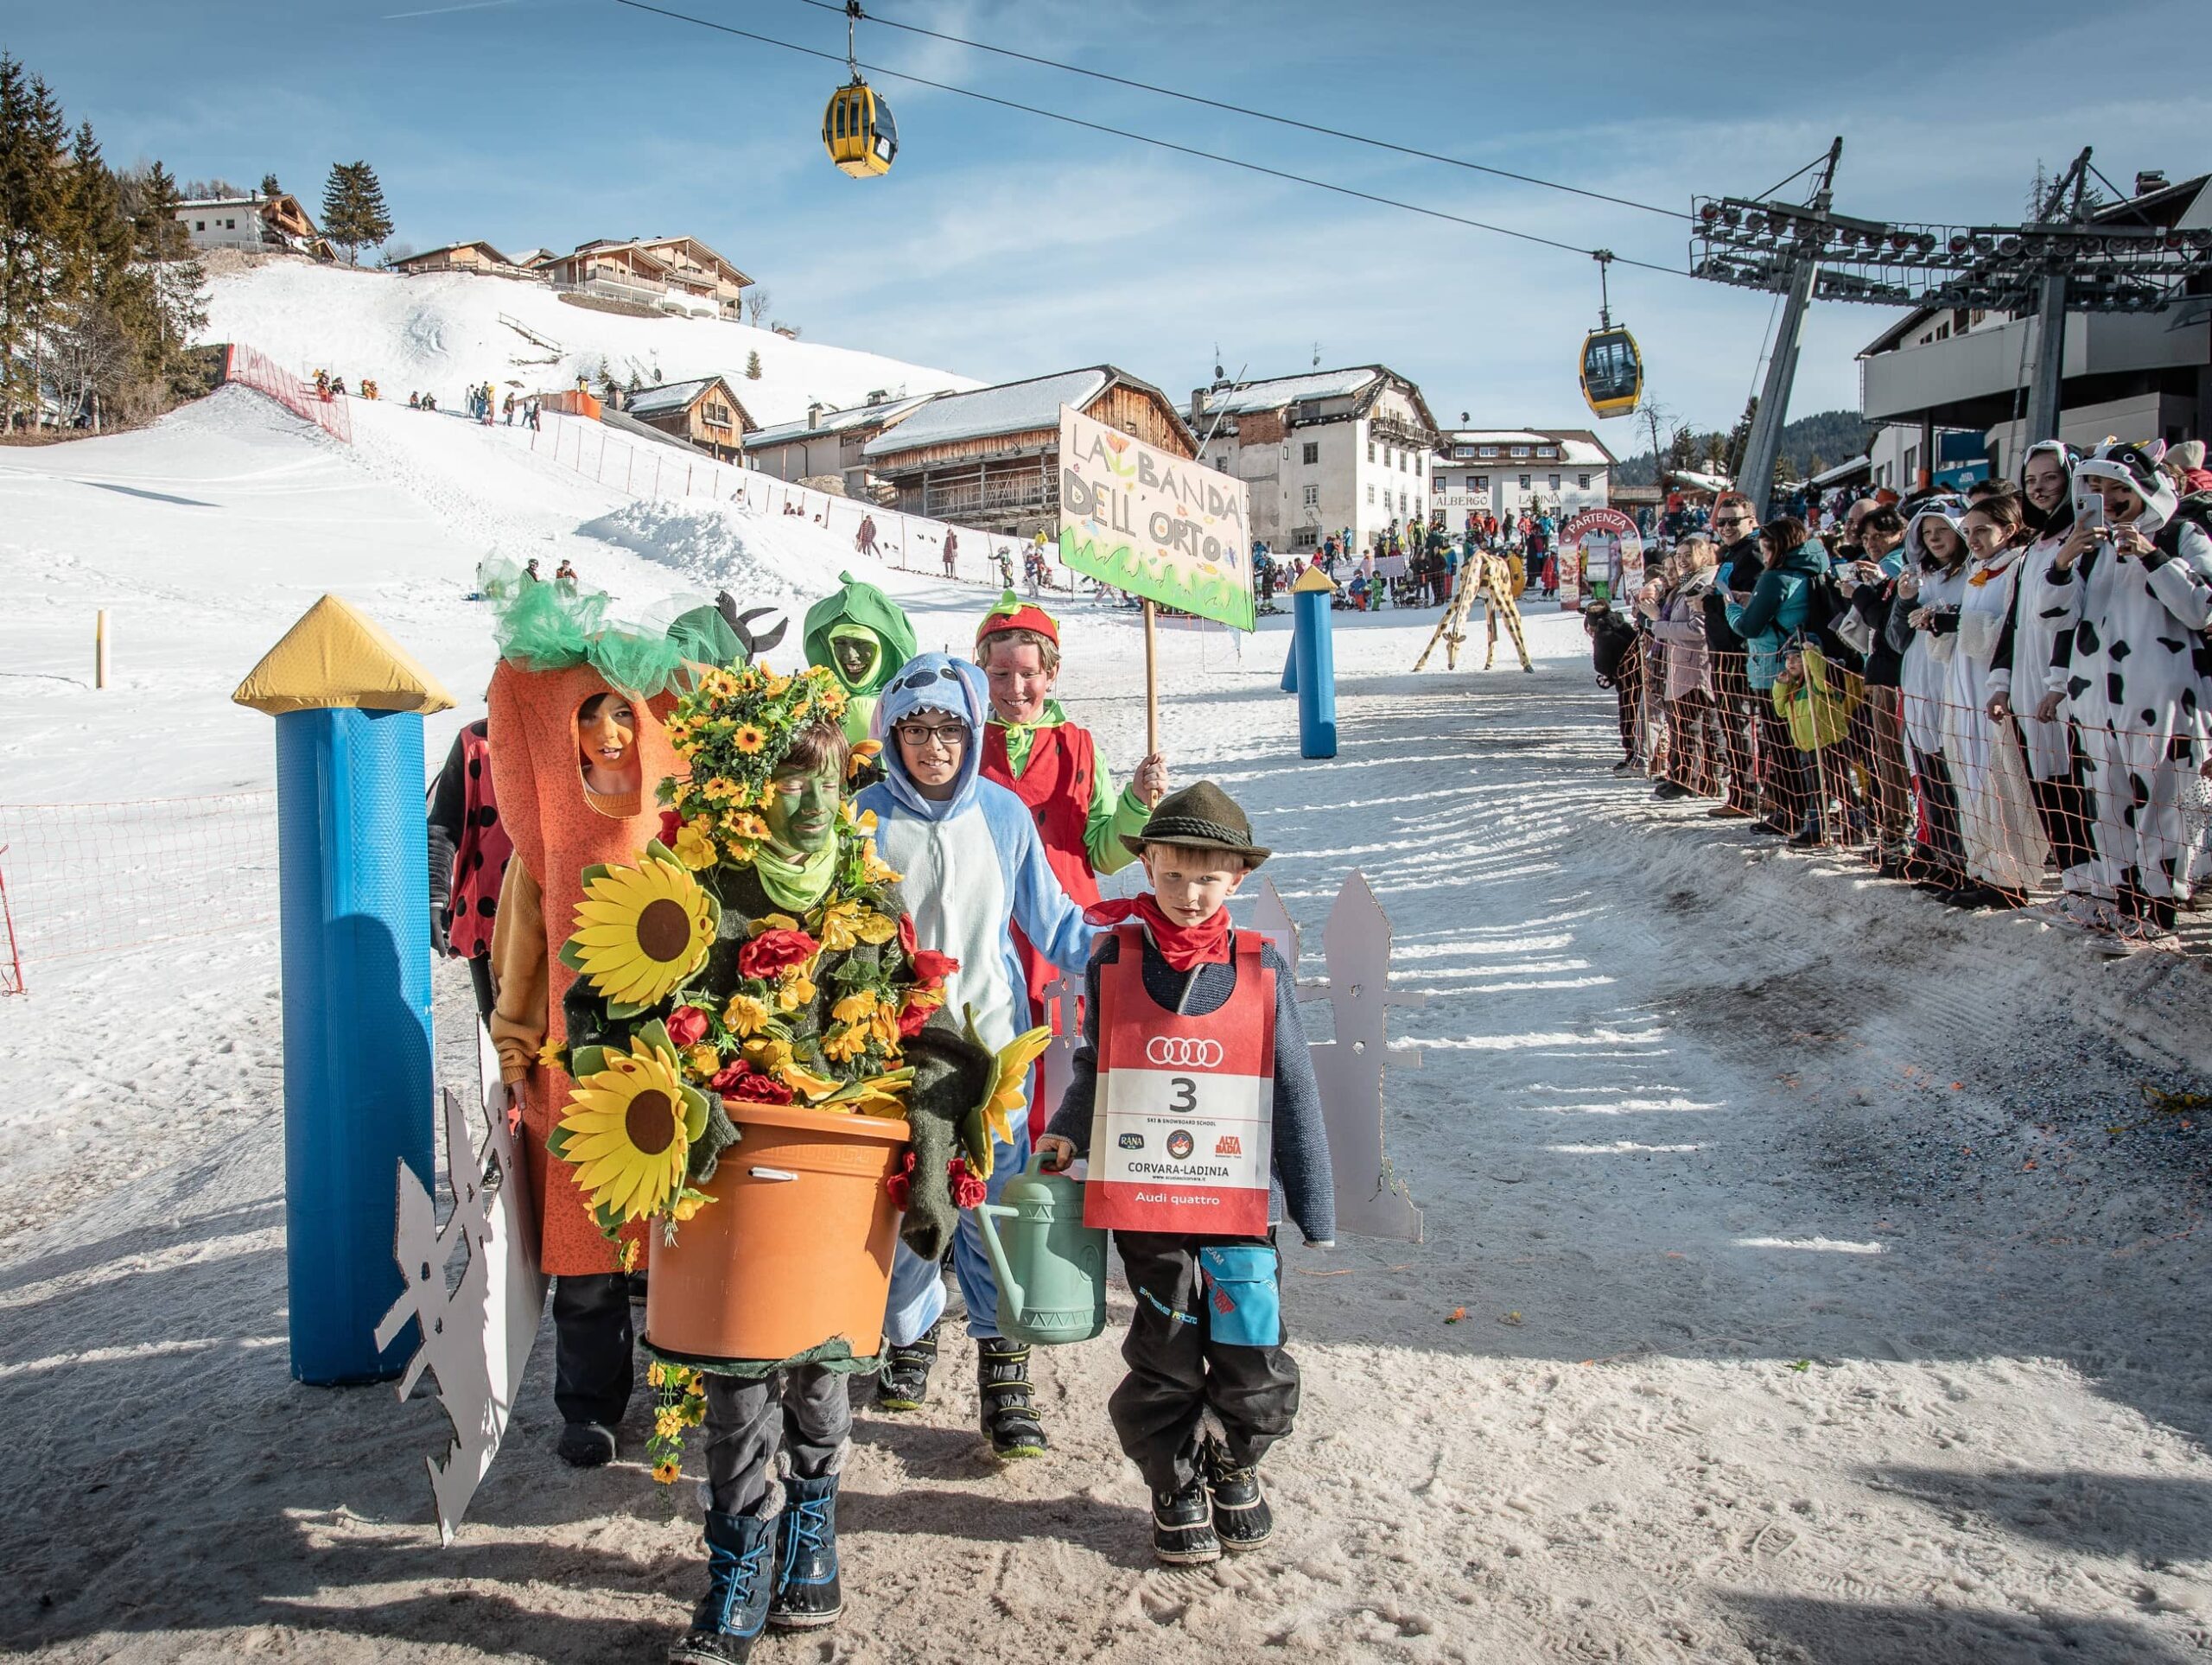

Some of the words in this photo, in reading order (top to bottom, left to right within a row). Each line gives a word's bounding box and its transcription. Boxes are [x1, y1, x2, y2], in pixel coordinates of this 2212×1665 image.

[1073, 423, 1110, 472] LA
[1138, 451, 1243, 530] BANDA
[1437, 496, 1488, 506] ALBERGO
[1568, 512, 1627, 533] PARTENZA
[1169, 1077, 1198, 1113] 3
[1121, 1136, 1142, 1146] RANA
[1219, 1135, 1240, 1146] ALTA
[1215, 1144, 1242, 1154] BADIA
[1128, 1161, 1230, 1177] CORVARA-LADINIA
[1135, 1192, 1167, 1203] Audi
[1171, 1194, 1220, 1205] quattro
